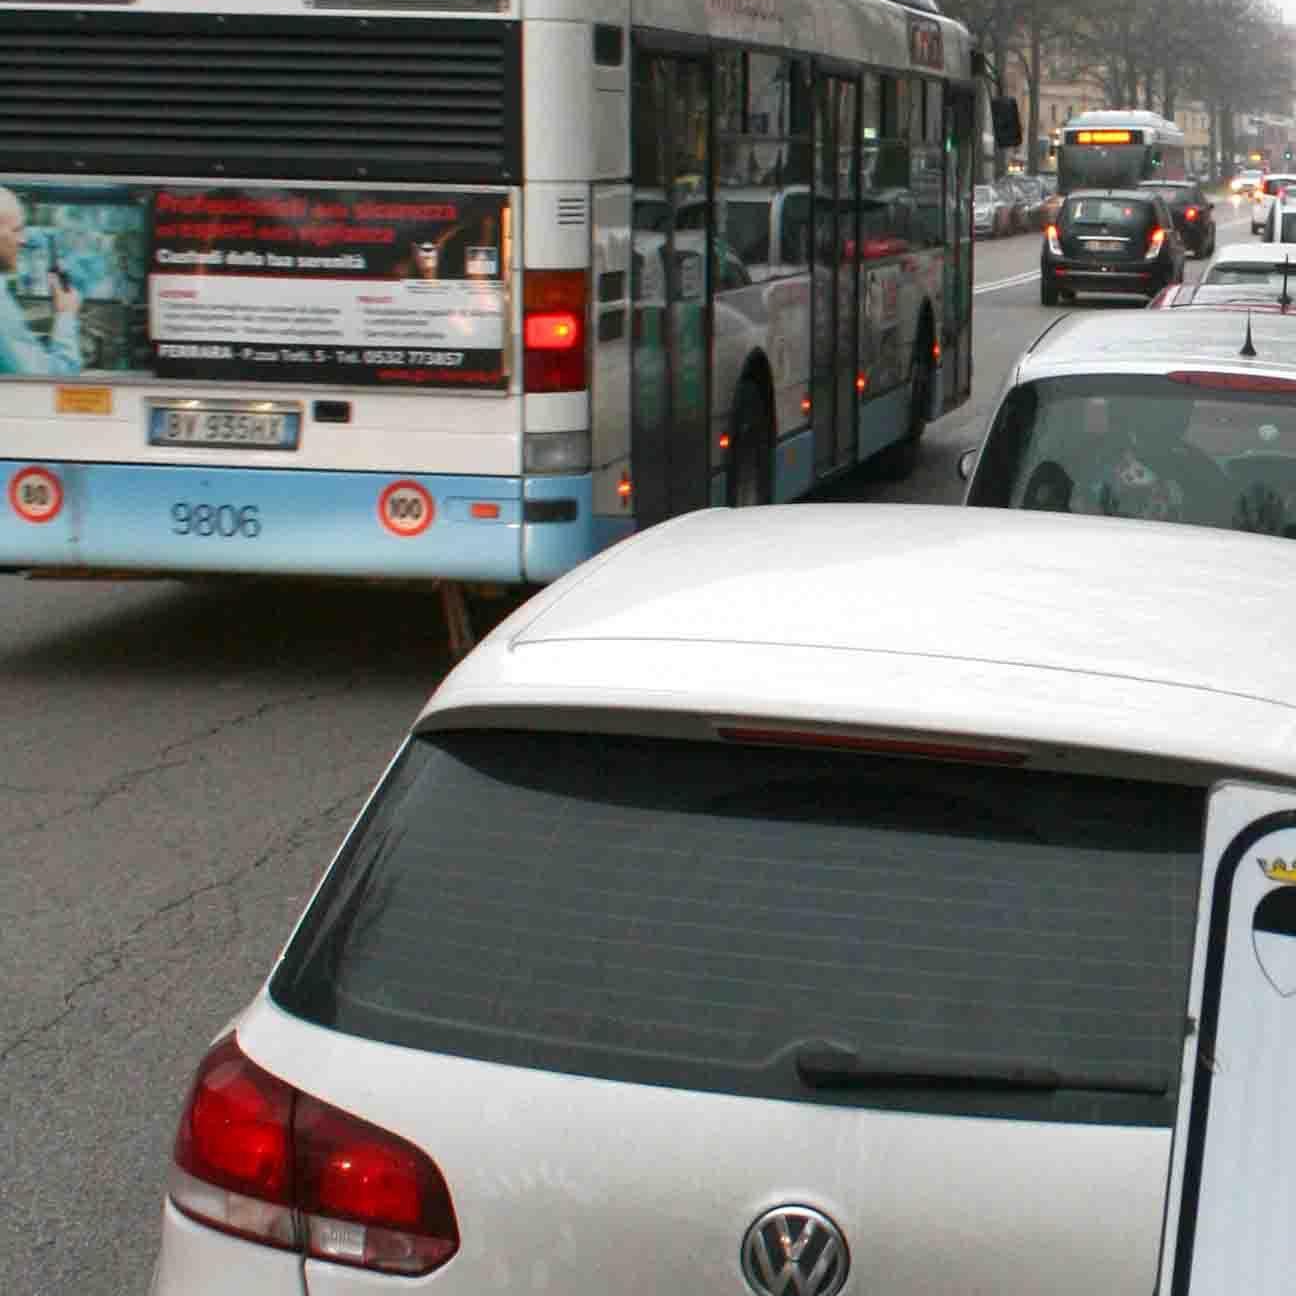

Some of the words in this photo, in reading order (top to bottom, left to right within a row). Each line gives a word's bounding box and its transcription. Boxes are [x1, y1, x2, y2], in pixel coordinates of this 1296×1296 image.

[157, 344, 232, 359] FERRARA
[390, 497, 424, 520] 100
[170, 502, 262, 539] 9806
